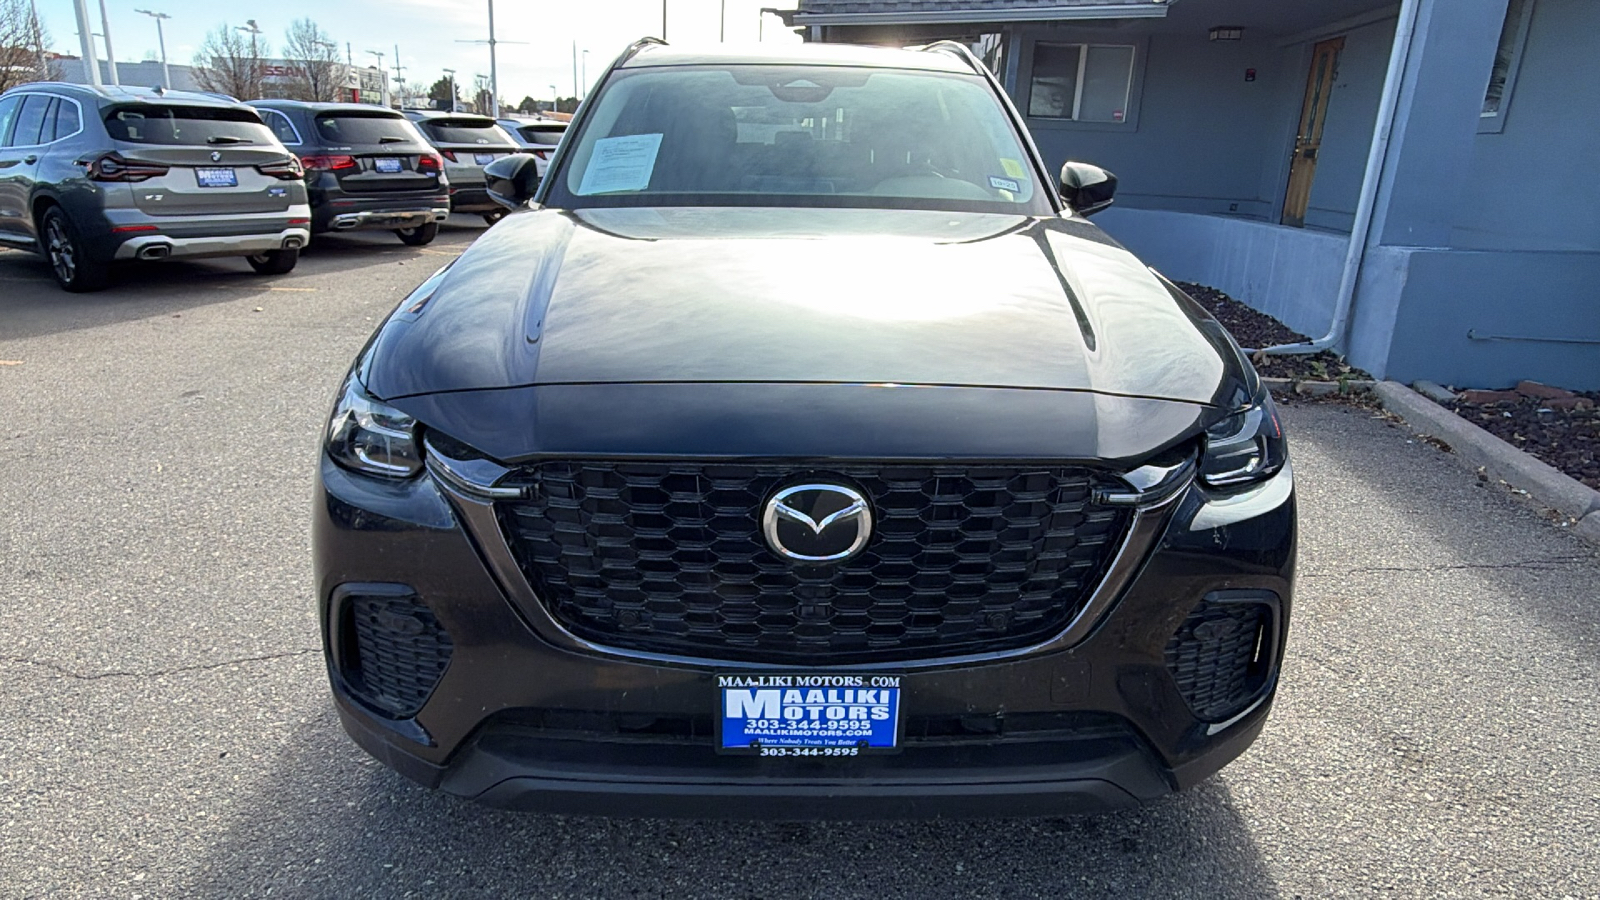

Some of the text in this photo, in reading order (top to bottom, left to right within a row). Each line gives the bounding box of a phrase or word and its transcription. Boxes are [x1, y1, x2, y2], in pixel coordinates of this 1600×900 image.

[746, 719, 871, 730] 303-344-9595
[744, 728, 873, 736] MAALIKIMOTORS.COM
[779, 737, 802, 746] Nobody
[760, 747, 859, 757] 303-344-9595
